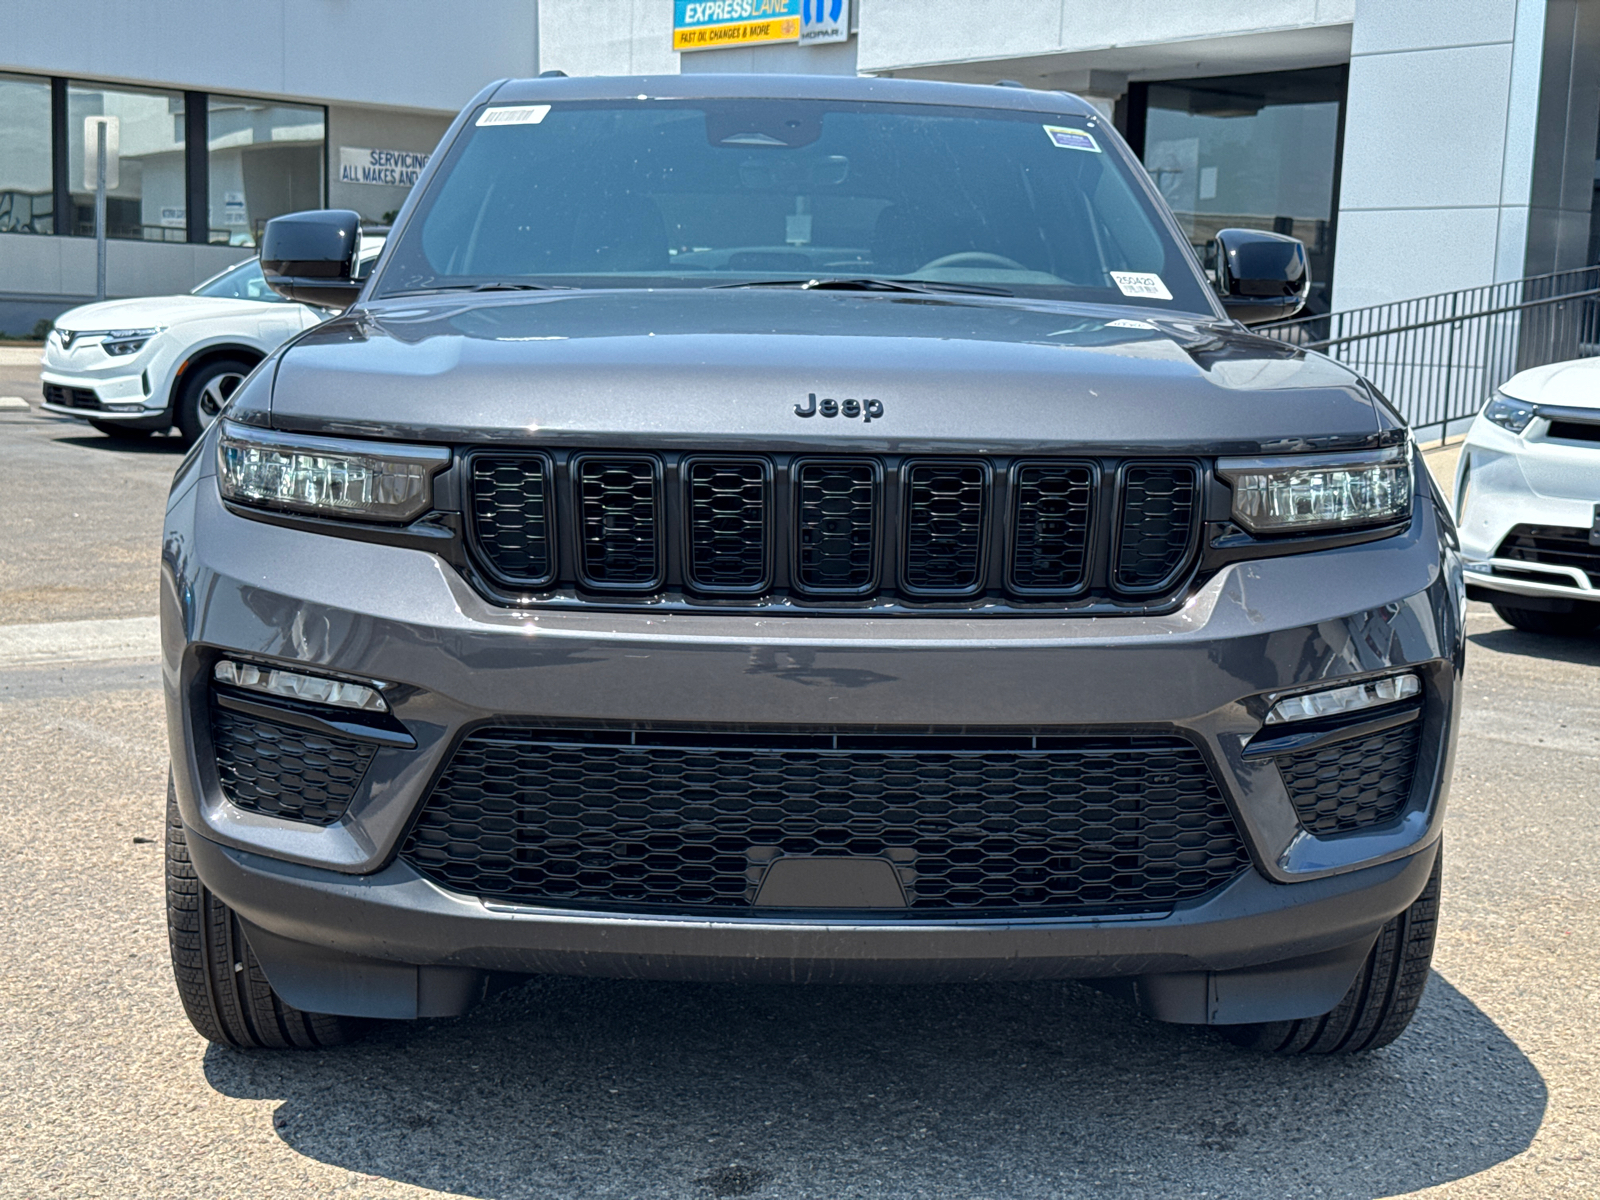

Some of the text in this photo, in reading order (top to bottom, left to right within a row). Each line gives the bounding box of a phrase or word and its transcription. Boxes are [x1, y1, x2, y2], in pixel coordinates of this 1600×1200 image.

[680, 24, 770, 43] FAST OIL CHANGES & MORE
[801, 29, 839, 39] MOPAR
[342, 165, 419, 186] ALL MAKES AND
[793, 393, 884, 423] Jeep
